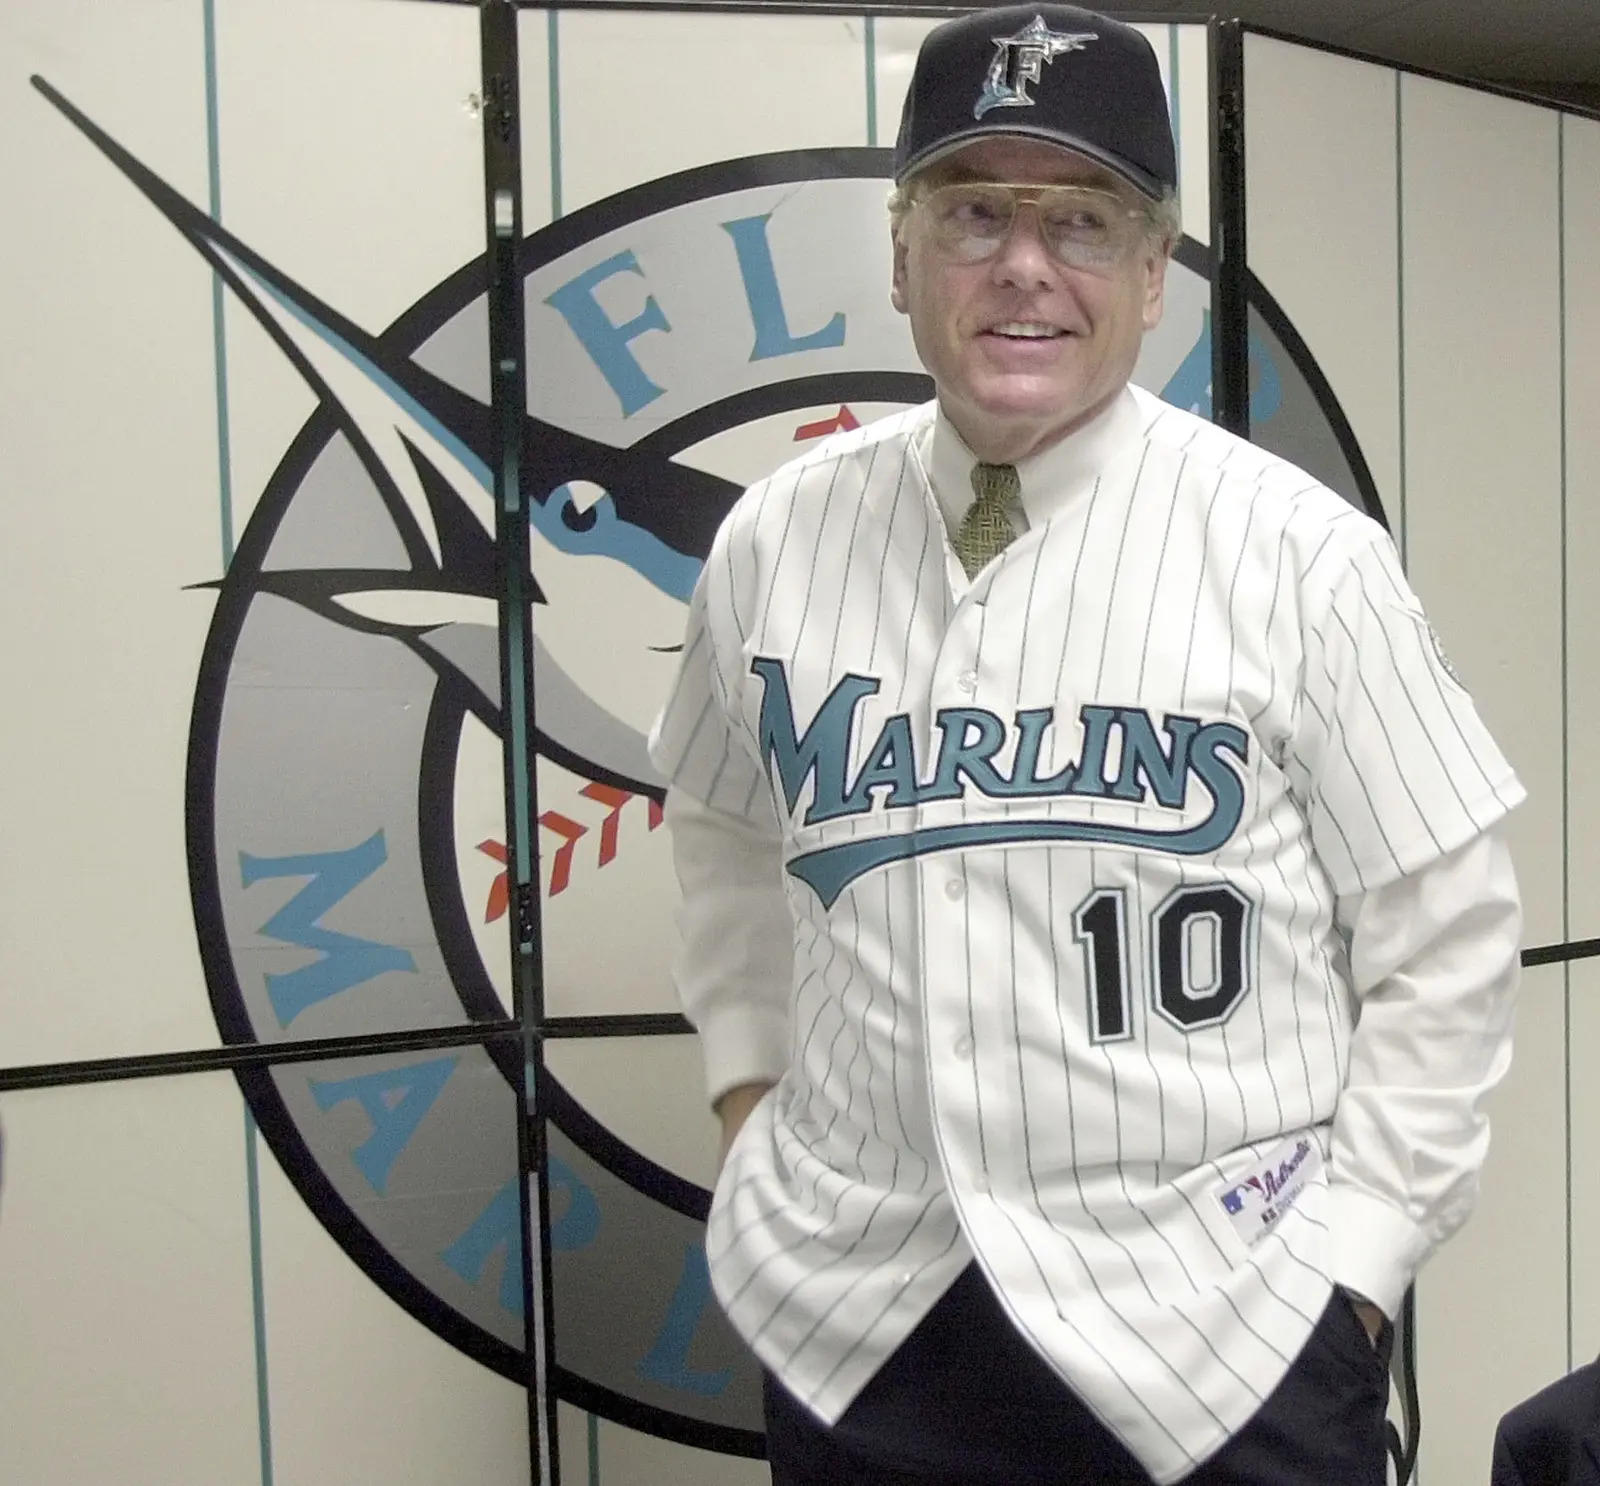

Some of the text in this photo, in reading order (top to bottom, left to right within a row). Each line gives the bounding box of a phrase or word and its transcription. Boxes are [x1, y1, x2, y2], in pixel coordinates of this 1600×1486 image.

[751, 656, 1250, 856] MARLINS
[1071, 880, 1254, 1046] 10
[238, 827, 734, 1396] MARL
